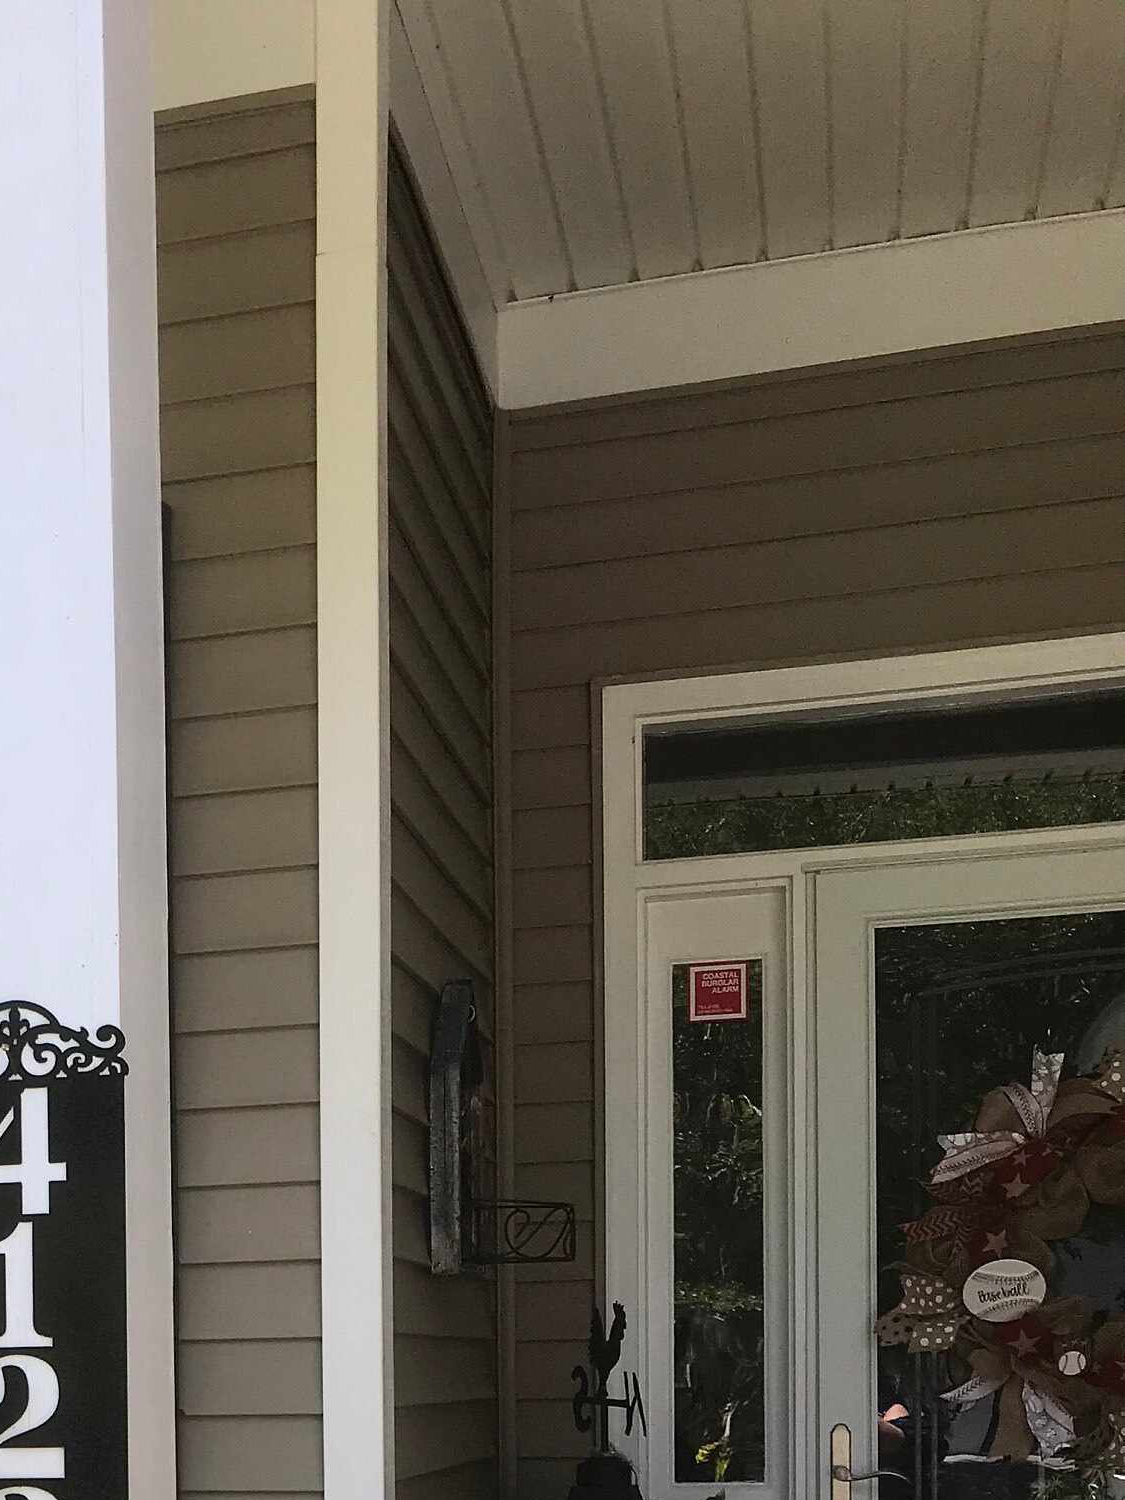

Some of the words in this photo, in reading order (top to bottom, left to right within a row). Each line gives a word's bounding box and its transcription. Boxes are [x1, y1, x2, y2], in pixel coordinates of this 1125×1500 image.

[702, 971, 739, 980] COASTAL
[701, 979, 739, 988] BURGLAR
[711, 985, 740, 994] ALARM
[977, 1282, 1030, 1303] Baseball
